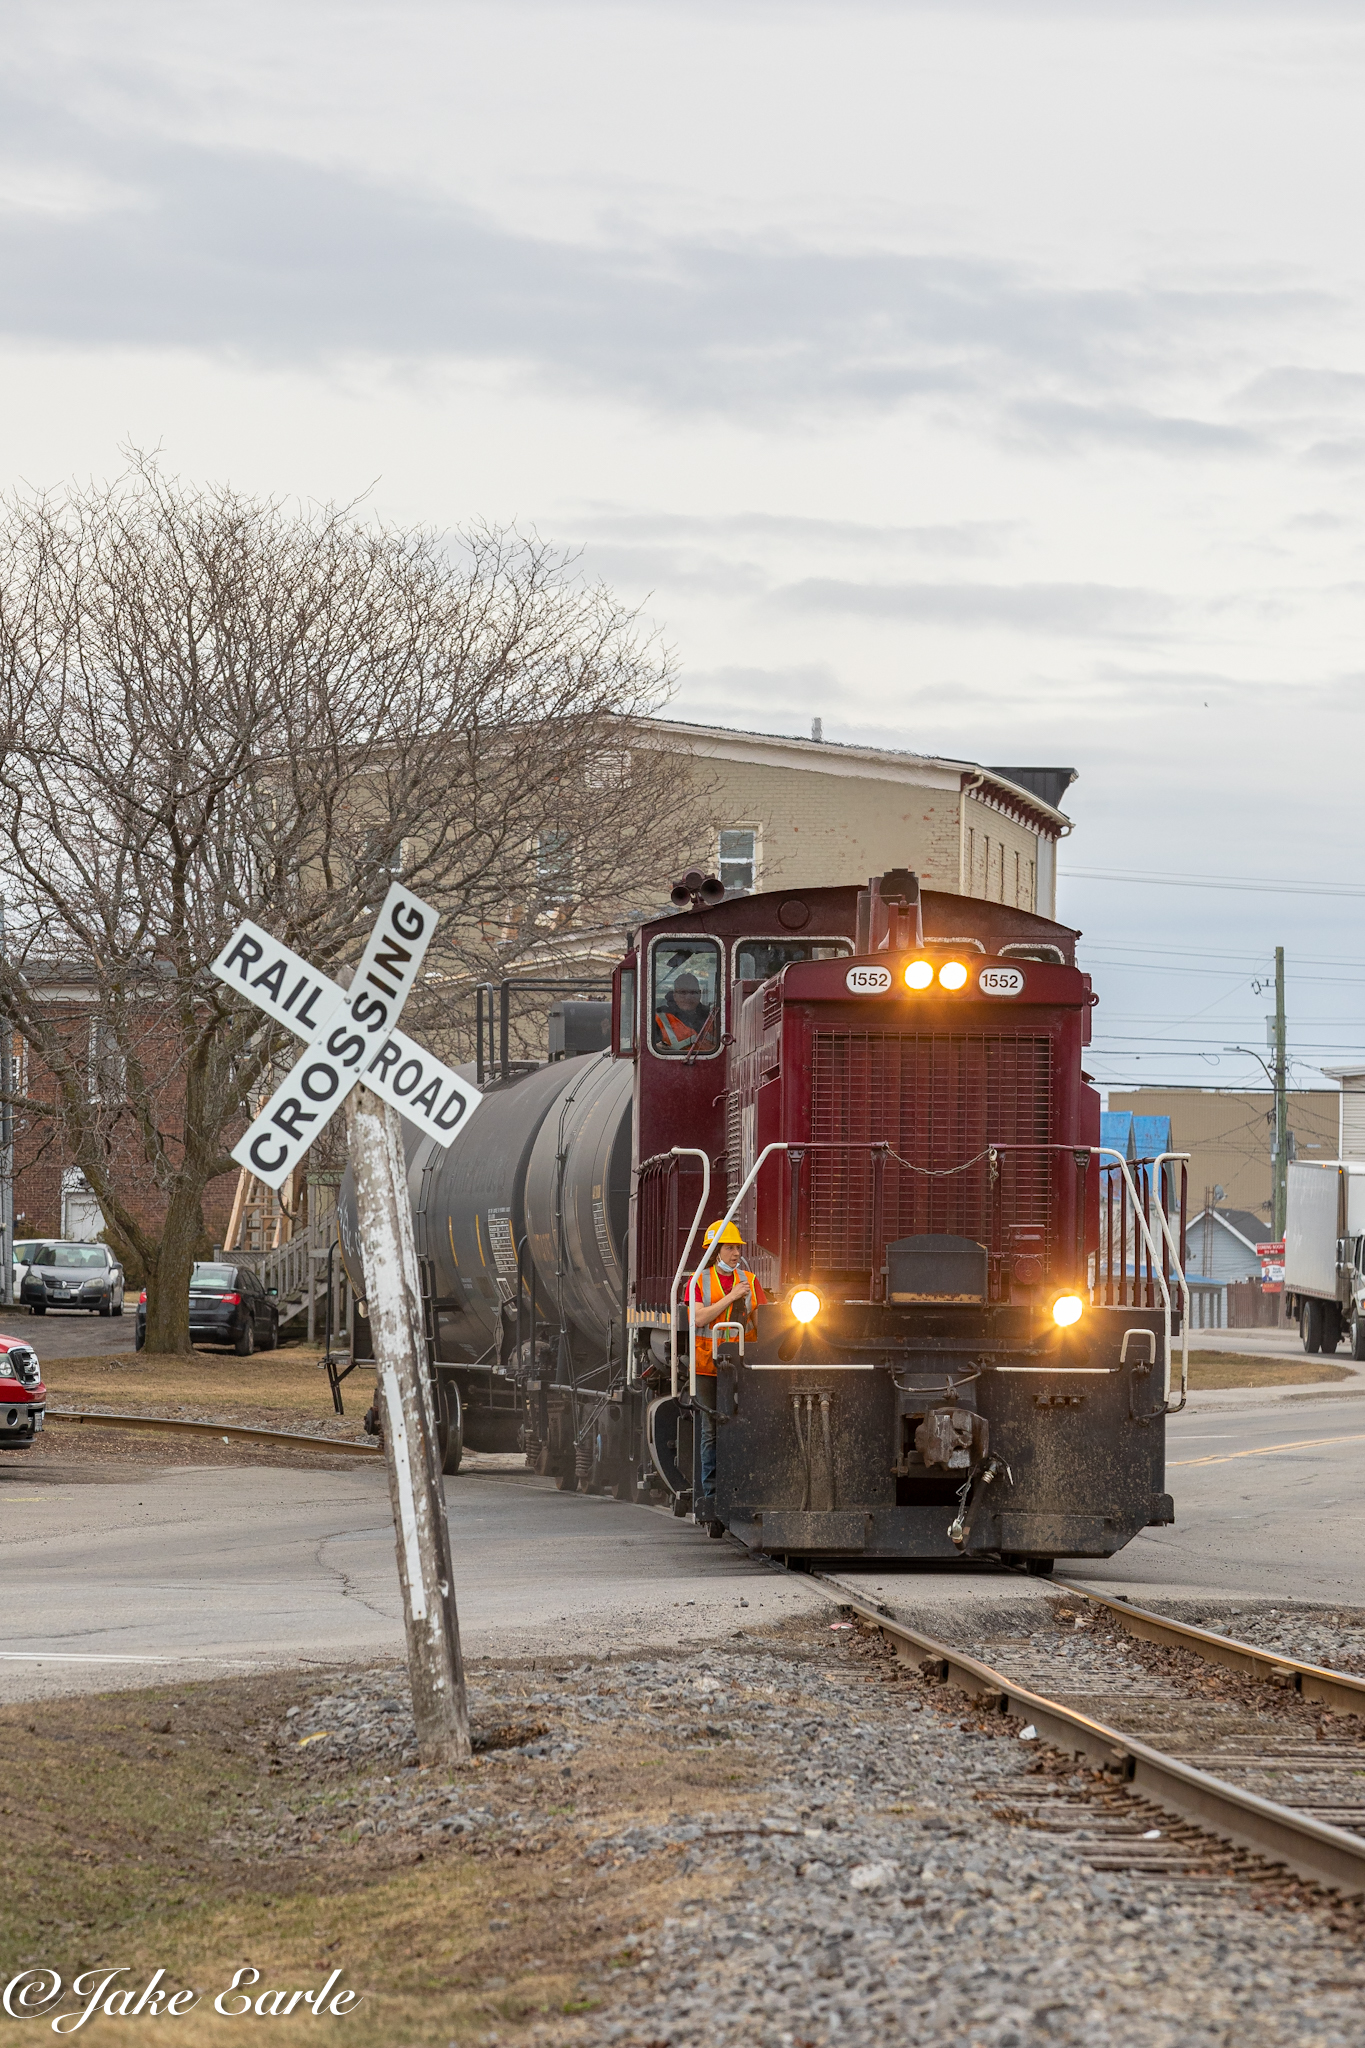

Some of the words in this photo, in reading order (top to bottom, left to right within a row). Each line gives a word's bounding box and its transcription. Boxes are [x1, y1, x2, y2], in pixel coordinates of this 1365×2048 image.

[223, 933, 323, 1030] RAIL
[367, 1039, 467, 1130] ROAD
[850, 972, 888, 987] 1552
[982, 974, 1018, 989] 1552
[249, 901, 424, 1172] CROSSING
